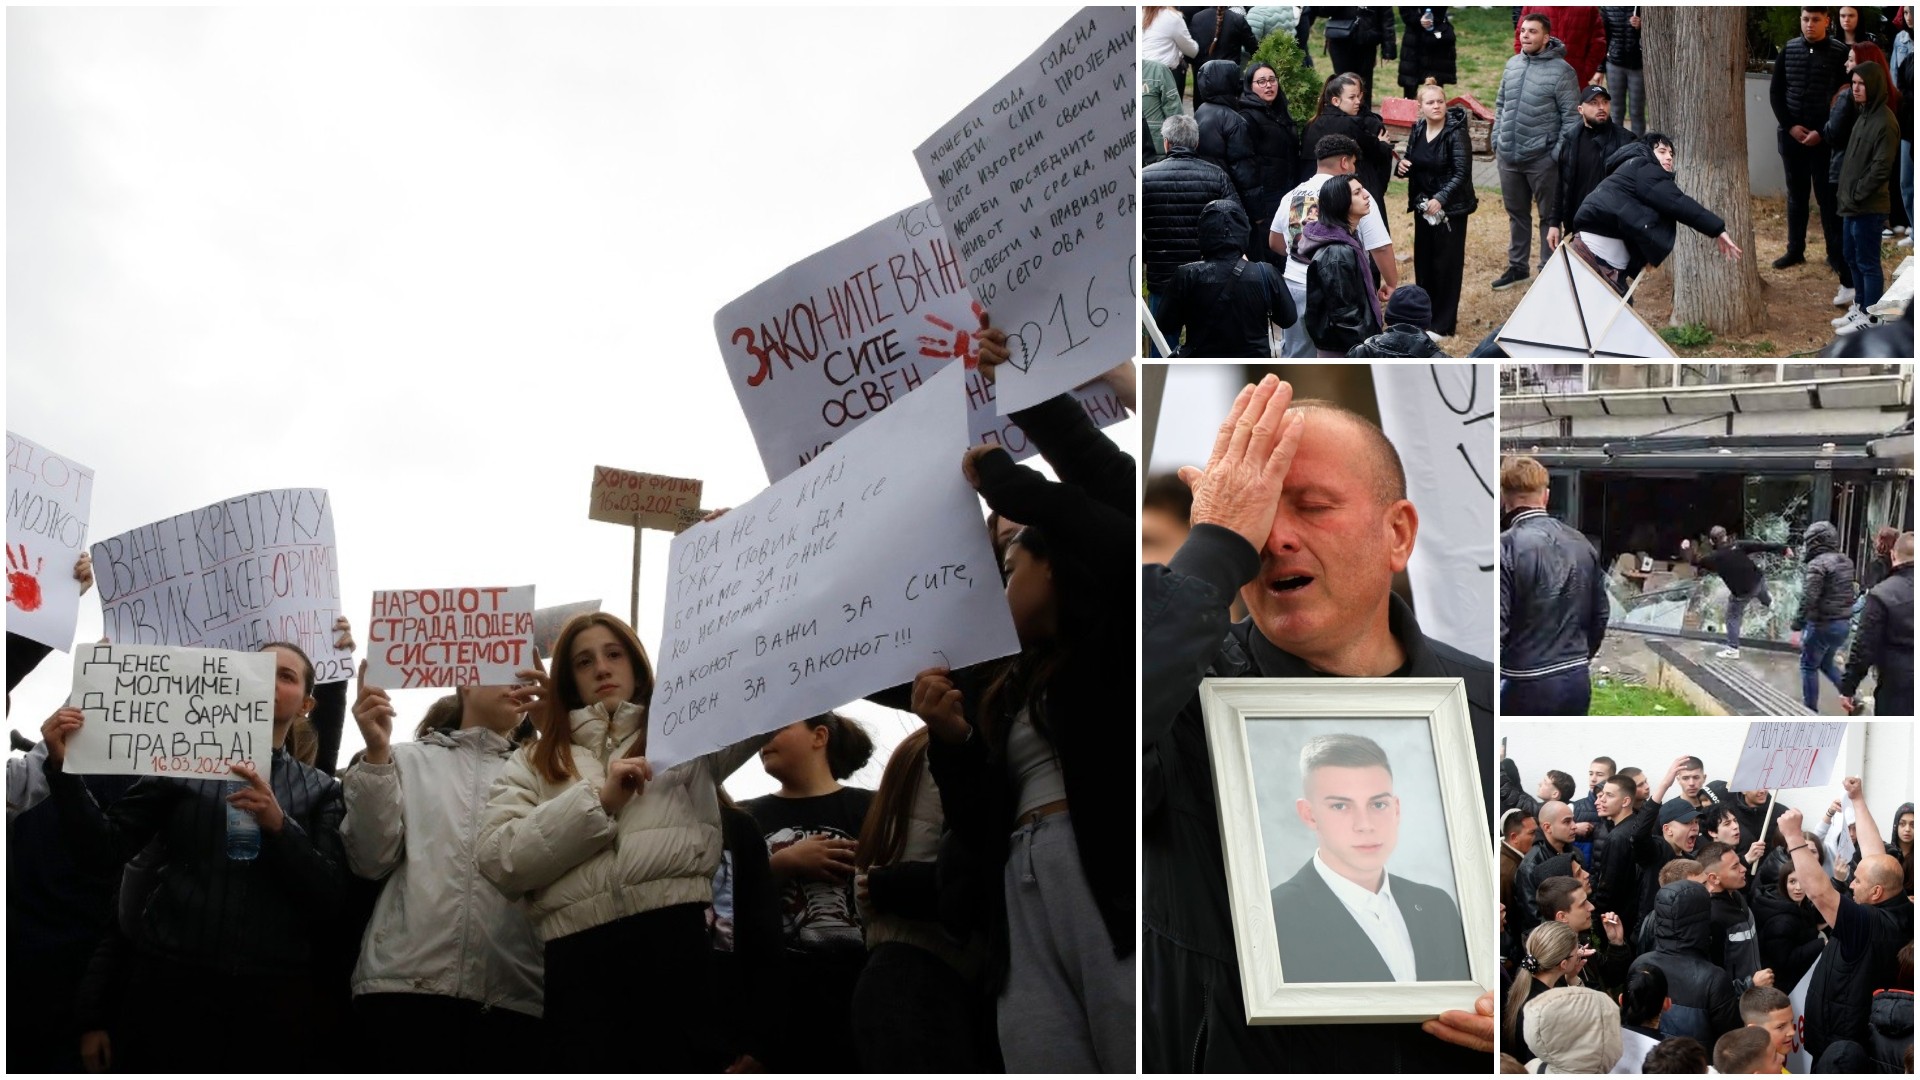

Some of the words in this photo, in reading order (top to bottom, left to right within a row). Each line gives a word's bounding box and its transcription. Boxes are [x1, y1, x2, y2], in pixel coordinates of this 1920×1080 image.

[961, 218, 1004, 261] ЖИВОТ
[976, 282, 997, 308] НО
[1052, 228, 1086, 257] ОВА
[731, 261, 894, 387] ЗАКОНИТЕ
[823, 328, 907, 386] СИТЕ
[595, 469, 647, 492] ХОРОР
[6, 488, 89, 551] МОЛКОТ
[596, 491, 687, 516] 16.03.2025
[736, 528, 799, 572] ПОВИК
[811, 500, 846, 534] ДА
[677, 530, 720, 576] ОВА
[751, 566, 775, 593] ЗА
[372, 587, 510, 618] НАРОДОТ
[369, 616, 457, 643] СТРАДА
[461, 611, 534, 640] ДОДЕКА
[83, 646, 171, 676] ДЕНЕС
[202, 655, 229, 676] НЕ
[385, 639, 528, 667] СИСТЕМОТ
[662, 648, 740, 705] ЗАКОНОТ
[755, 618, 819, 659] ВАЖИ
[842, 593, 874, 624] ЗА
[115, 675, 241, 696] МОЛЧИМЕ!
[400, 666, 481, 689] УЖИВА
[742, 676, 767, 703] ЗА
[81, 692, 170, 724] ДЕНЕС
[108, 731, 253, 769] ПРАВДА!
[150, 756, 232, 776] 16.03.2025
